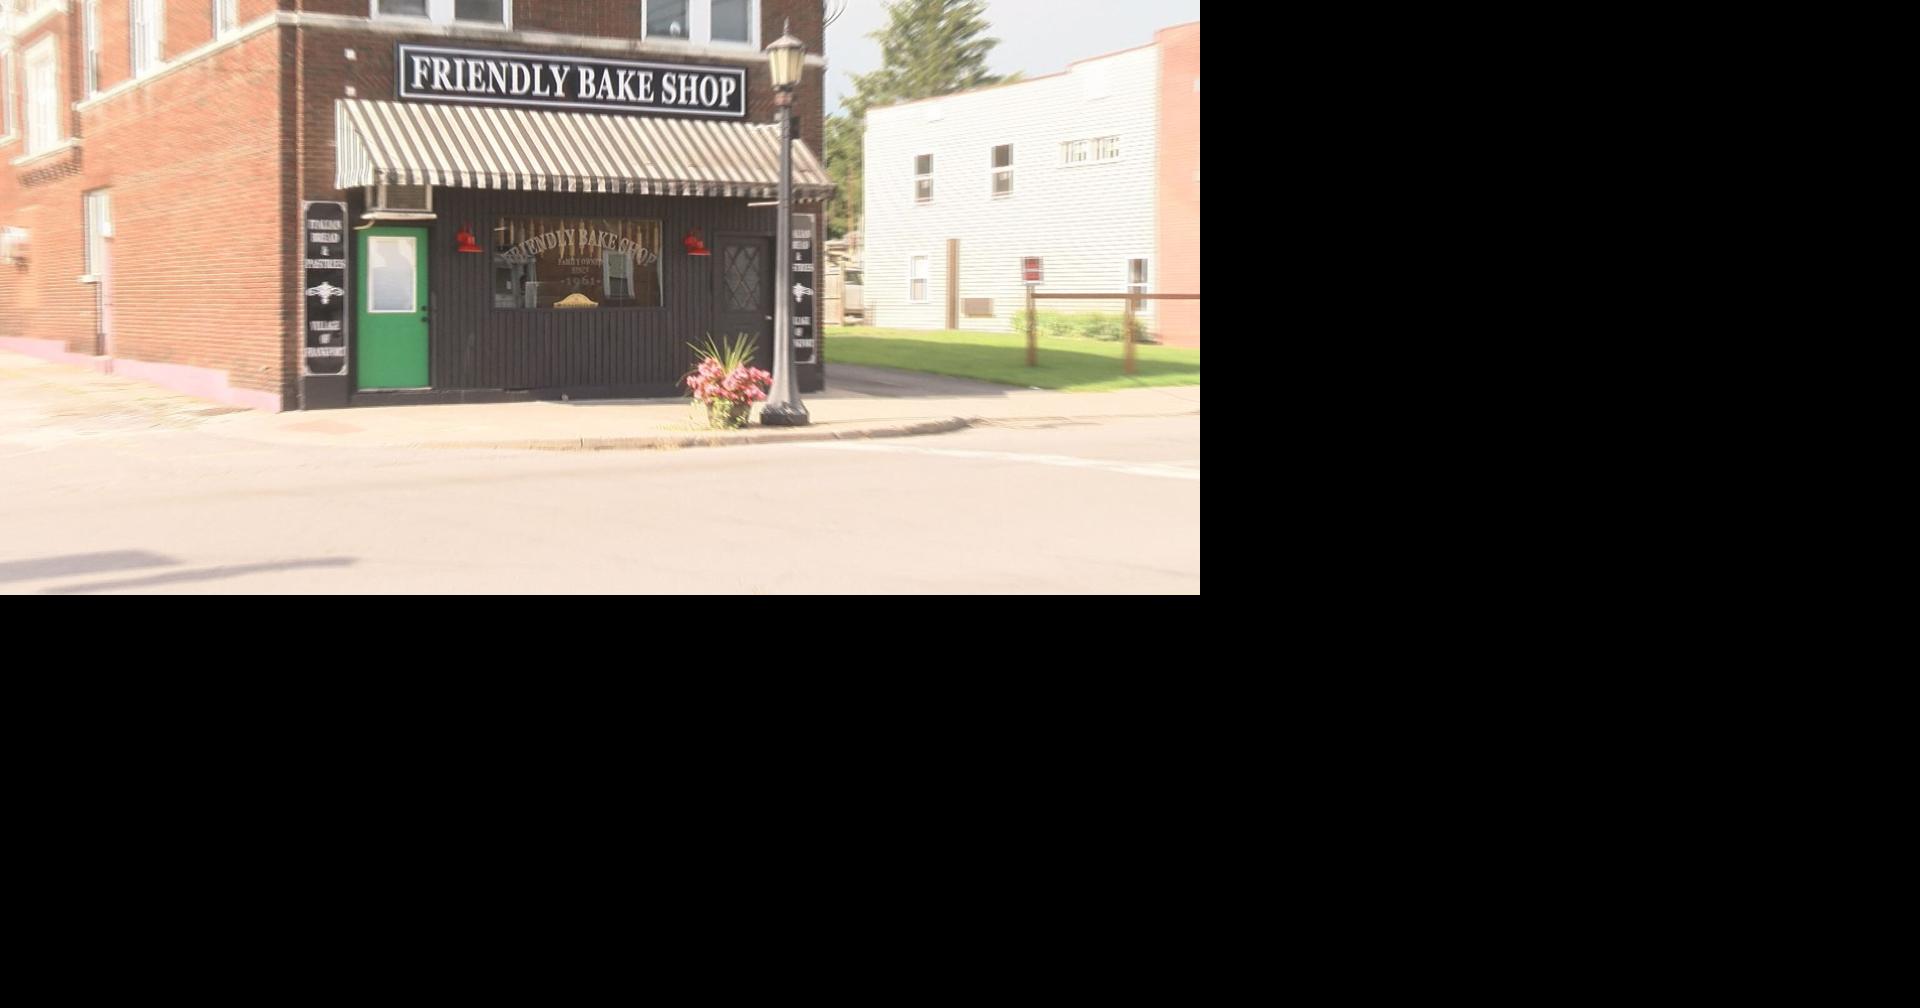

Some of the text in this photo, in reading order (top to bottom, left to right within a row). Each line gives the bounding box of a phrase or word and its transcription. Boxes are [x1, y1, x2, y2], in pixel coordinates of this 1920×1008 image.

[411, 55, 736, 107] FRIENDLY BAKE SHOP
[501, 228, 658, 267] FRIENDLY BAKE SHOP
